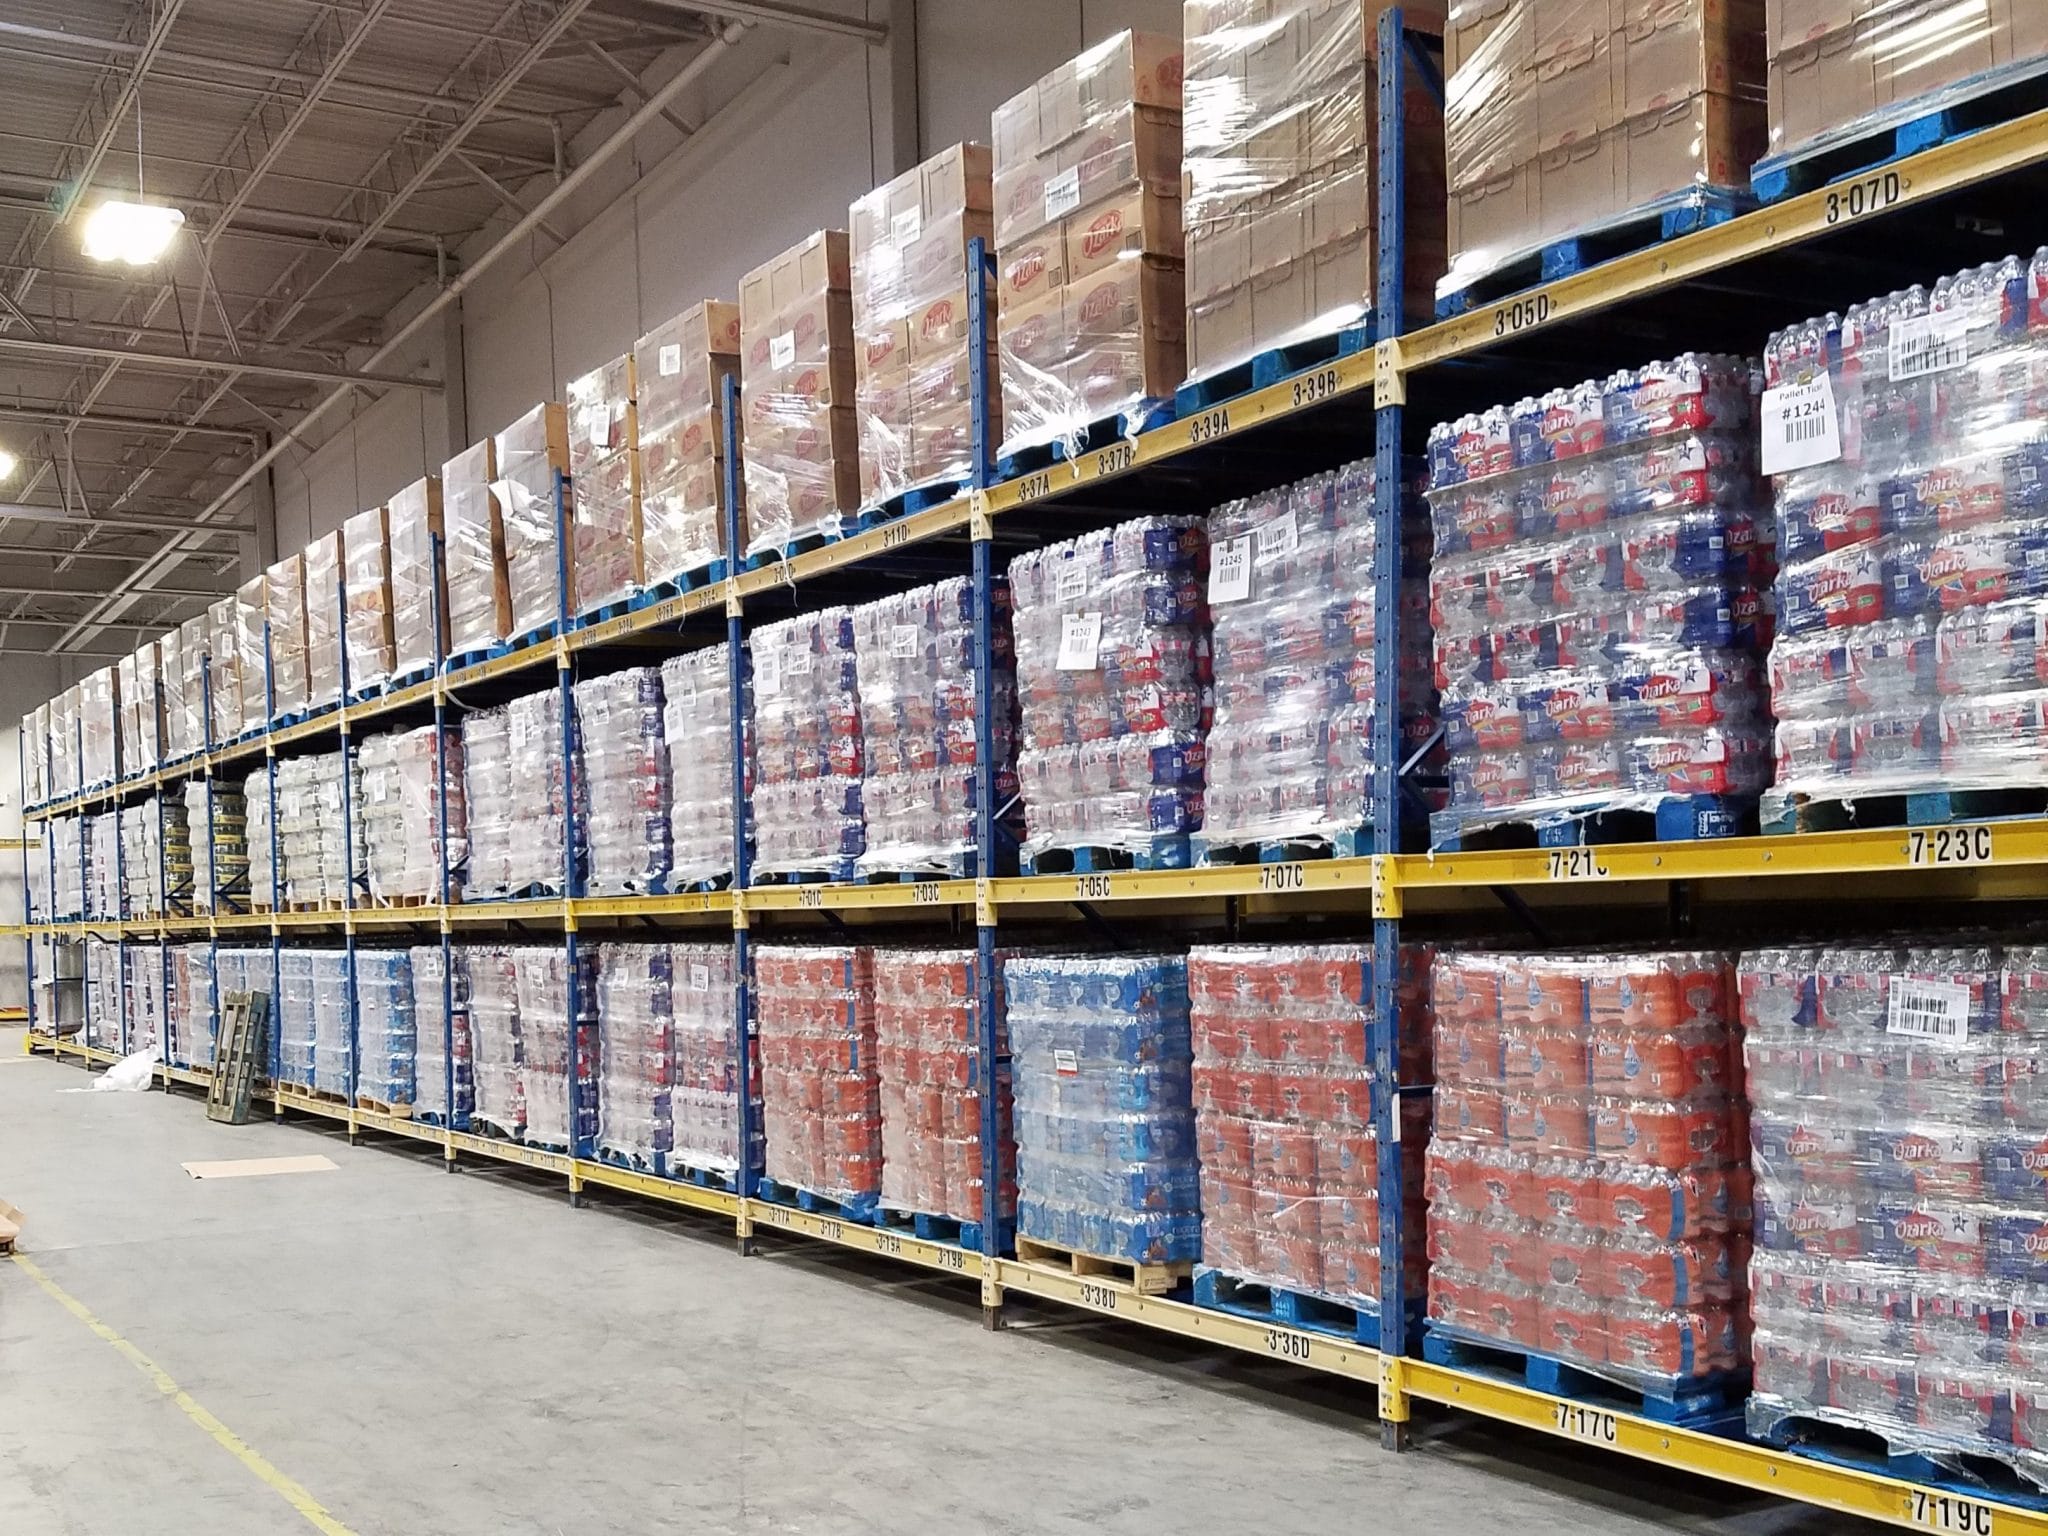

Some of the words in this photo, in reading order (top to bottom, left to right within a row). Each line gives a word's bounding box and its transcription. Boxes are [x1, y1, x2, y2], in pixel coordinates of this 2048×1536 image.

[1826, 172, 1899, 224] 3-07D
[1495, 293, 1548, 335] 3-05D
[1293, 370, 1336, 406] 3-39B
[1781, 398, 1825, 420] #1244
[1192, 409, 1230, 443] 3-39A
[1098, 446, 1131, 475] 3-37B
[1020, 473, 1050, 502] 3-37A
[1911, 827, 1990, 864] 7-23C
[1079, 876, 1110, 897] 7-05C
[1263, 865, 1304, 889] 7-07C
[801, 890, 822, 906] 7-01C
[915, 883, 939, 902] 7-03C
[820, 1218, 842, 1239] 3-17B
[1895, 1219, 1946, 1241] Ozarka
[938, 1246, 963, 1269] 3-19B
[1084, 1282, 1117, 1310] 3-38D
[1269, 1328, 1311, 1360] 3-36D
[1559, 1402, 1615, 1442] 7-17C
[1913, 1489, 1991, 1536] 7-19C
